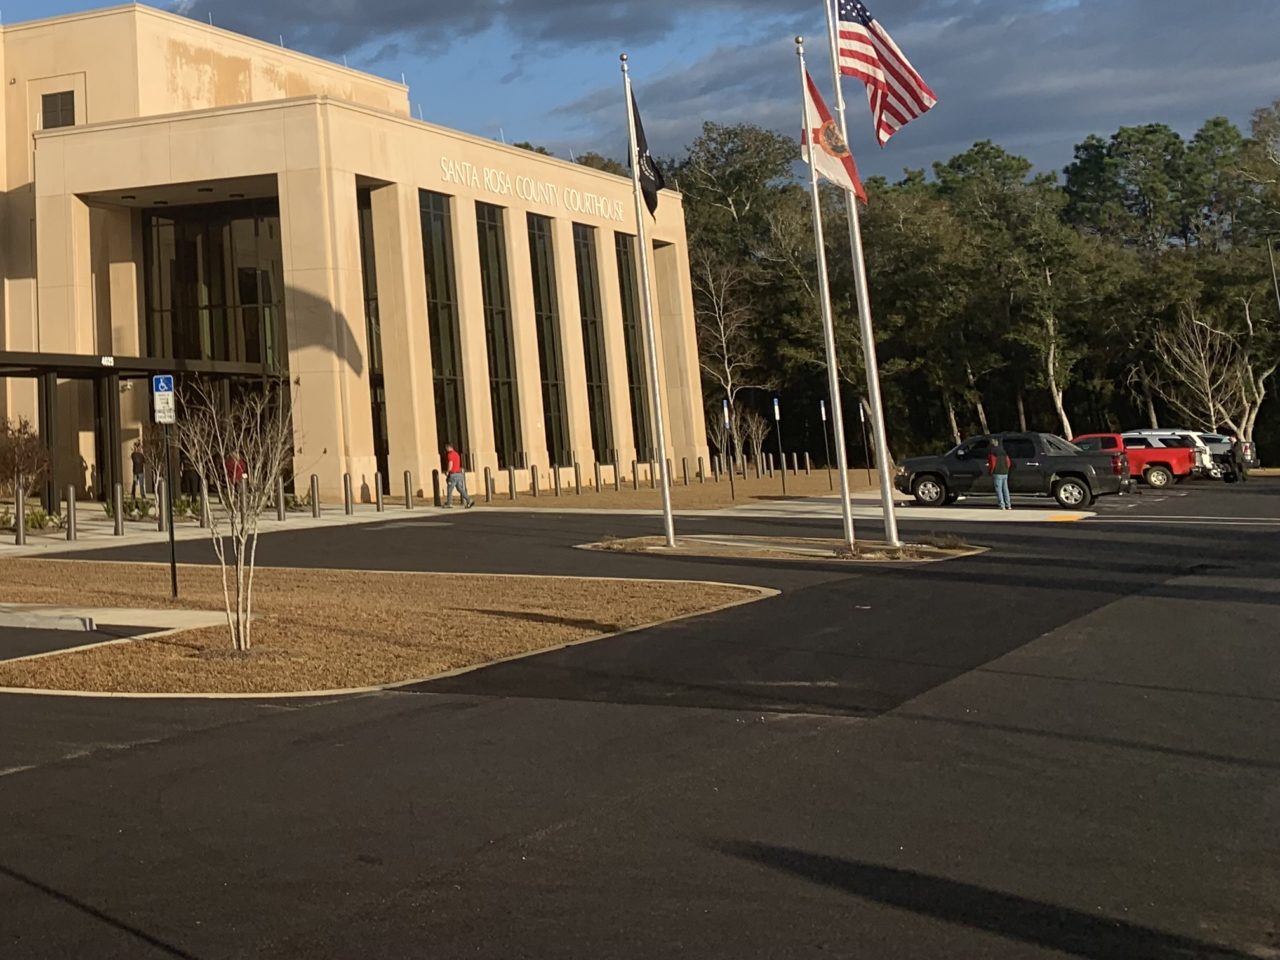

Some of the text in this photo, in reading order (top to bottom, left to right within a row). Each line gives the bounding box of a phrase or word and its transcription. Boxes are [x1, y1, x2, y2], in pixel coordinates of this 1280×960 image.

[440, 156, 625, 222] SANTA ROSA COUNTY COURTHOUSE
